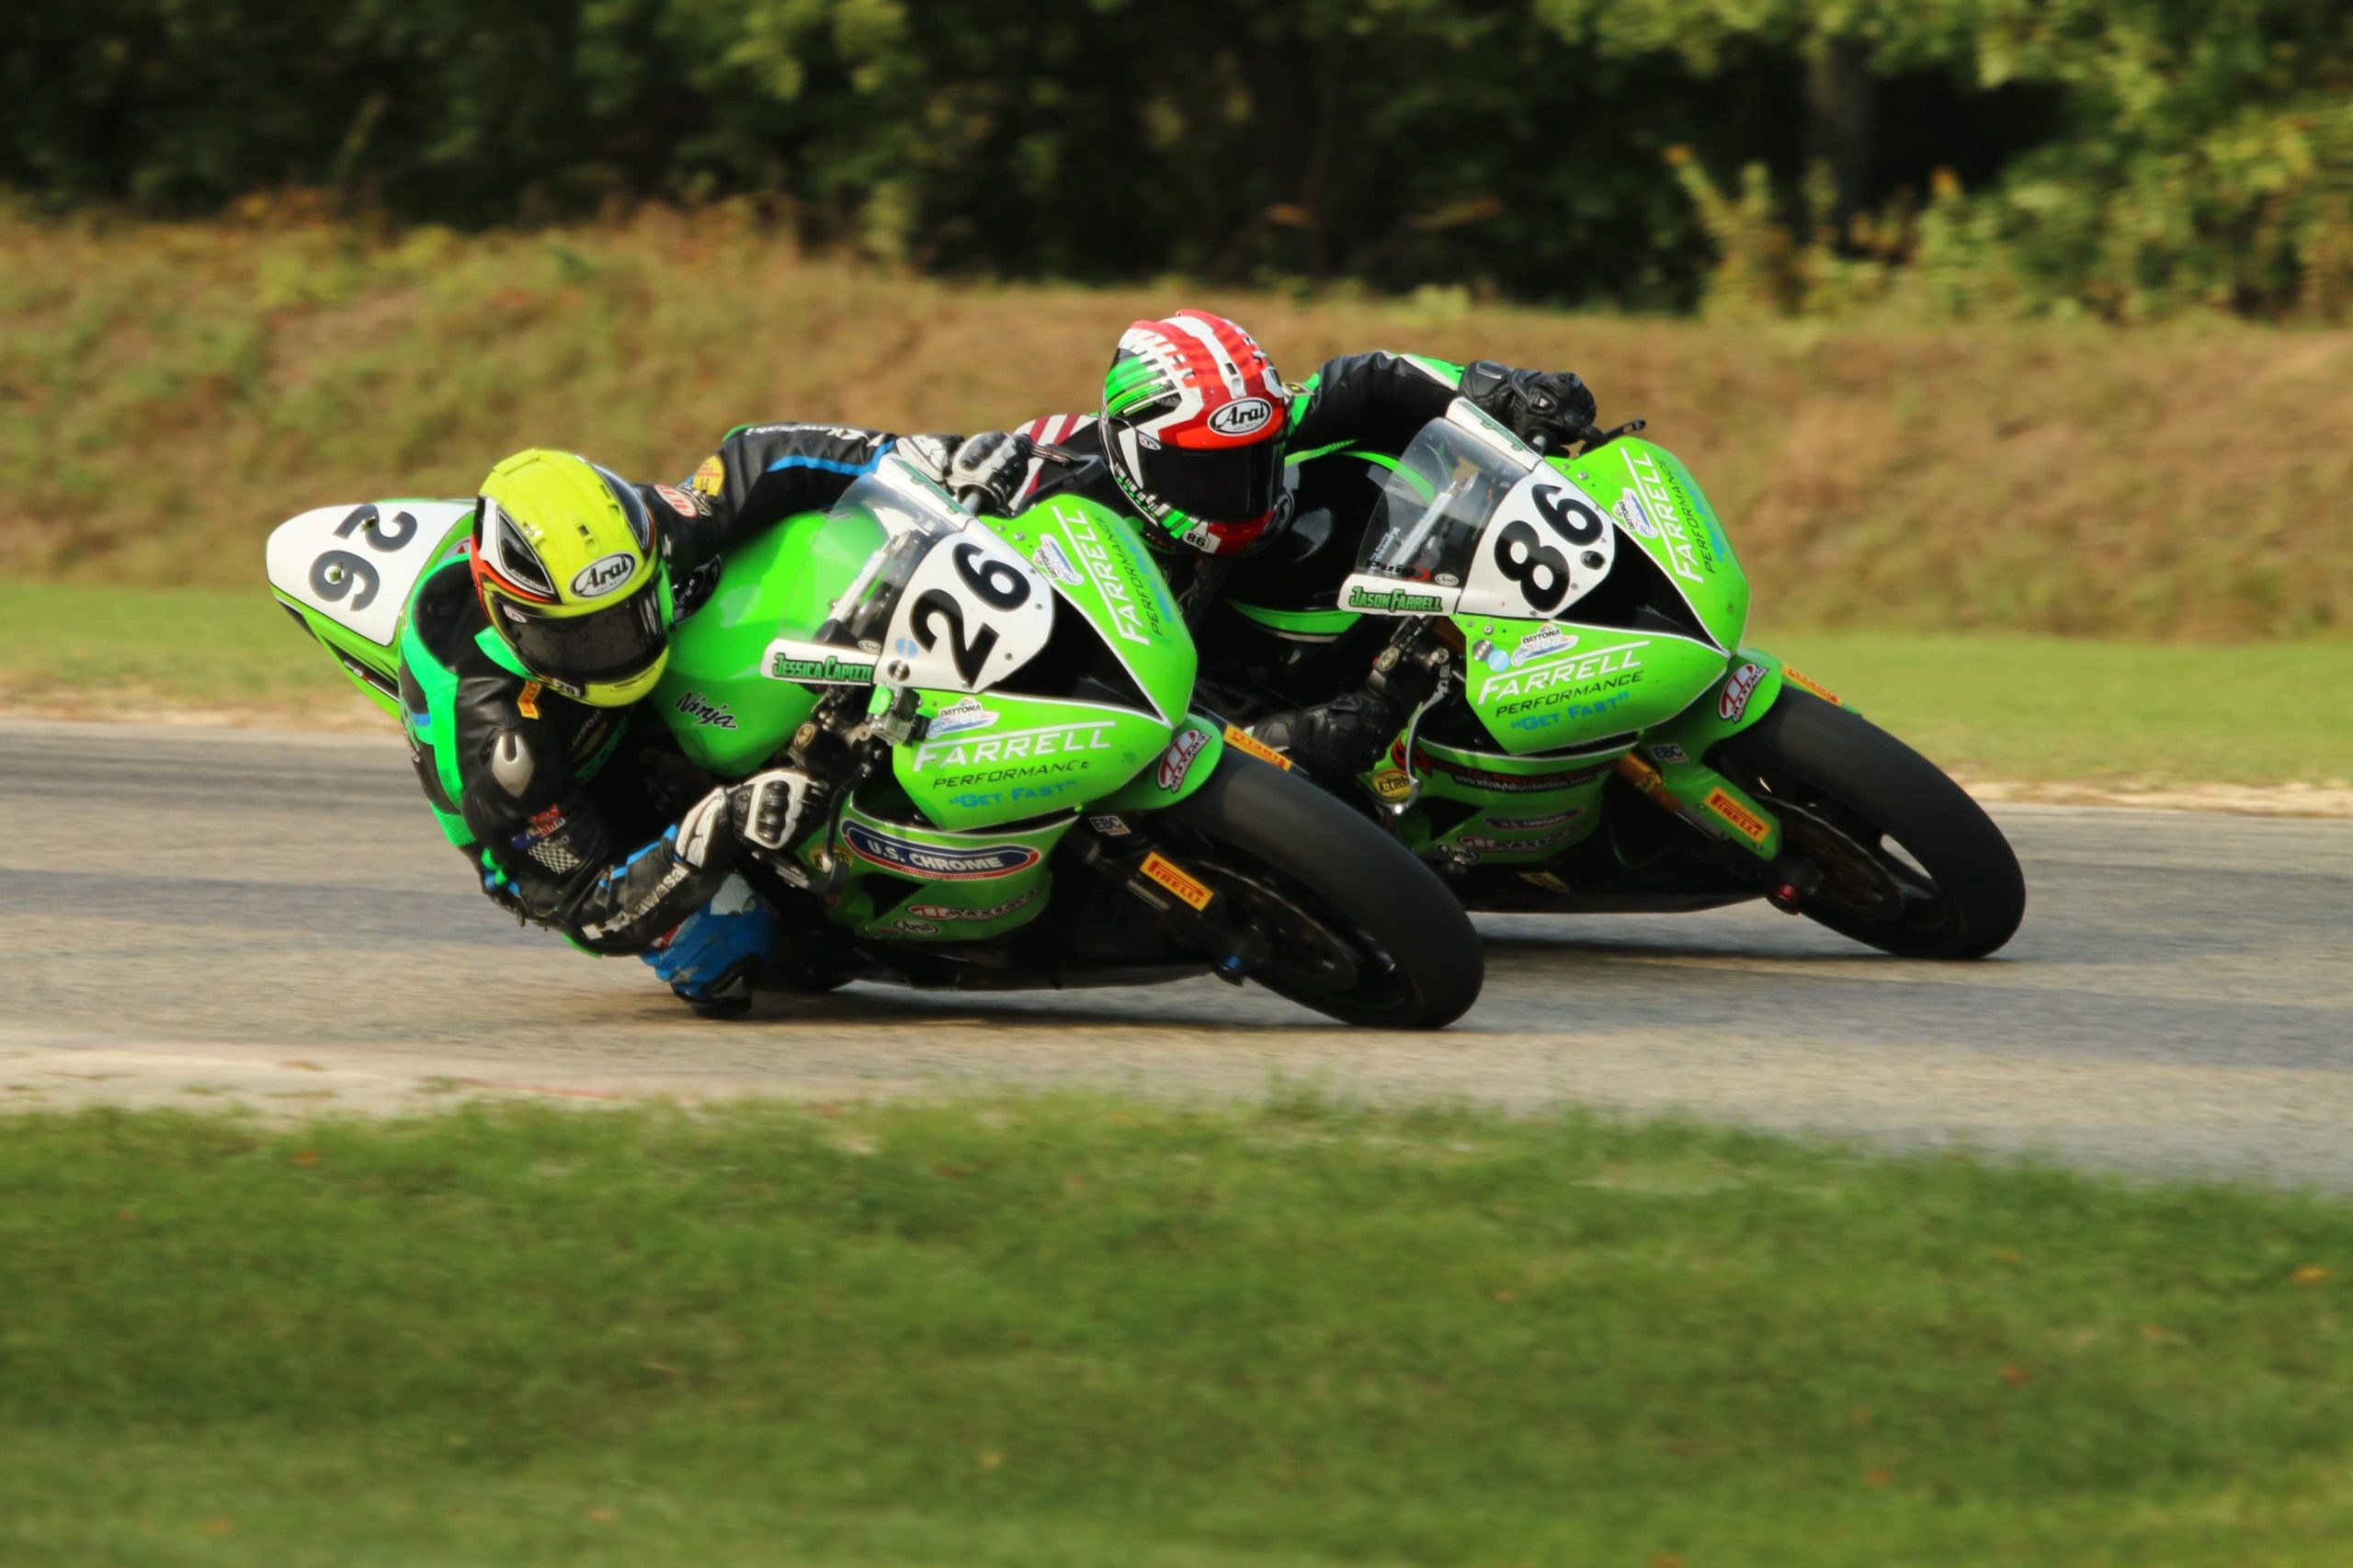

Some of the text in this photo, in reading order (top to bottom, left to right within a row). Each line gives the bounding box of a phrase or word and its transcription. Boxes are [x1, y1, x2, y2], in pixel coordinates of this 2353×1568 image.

[1216, 402, 1265, 428] Arai
[1620, 447, 1704, 584] FARRELL
[1186, 531, 1208, 548] 86
[1494, 483, 1605, 612] 86
[309, 504, 418, 612] 26
[576, 555, 629, 594] Arai
[1051, 506, 1151, 646] FARRELL
[909, 542, 1031, 689] 26
[1349, 586, 1443, 613] JASON FARRELL
[1522, 629, 1562, 644] DAYTONA
[773, 653, 823, 679] JESSICA
[1478, 641, 1651, 706] FARRELL
[555, 681, 576, 696] 26
[1495, 670, 1644, 718] PERFORMANCE
[676, 692, 737, 730] Ninja
[940, 704, 982, 717] DAYTONA
[913, 722, 1116, 772] FARRELL
[1653, 744, 1684, 759] EBC
[933, 759, 1089, 789] PERFORMANCE
[1094, 816, 1123, 831] EBC
[1710, 794, 1763, 837] PIRELLI
[867, 838, 1004, 871] U.S. CHROME
[1148, 859, 1205, 904] PIRELLI
[897, 920, 935, 935] Arai
